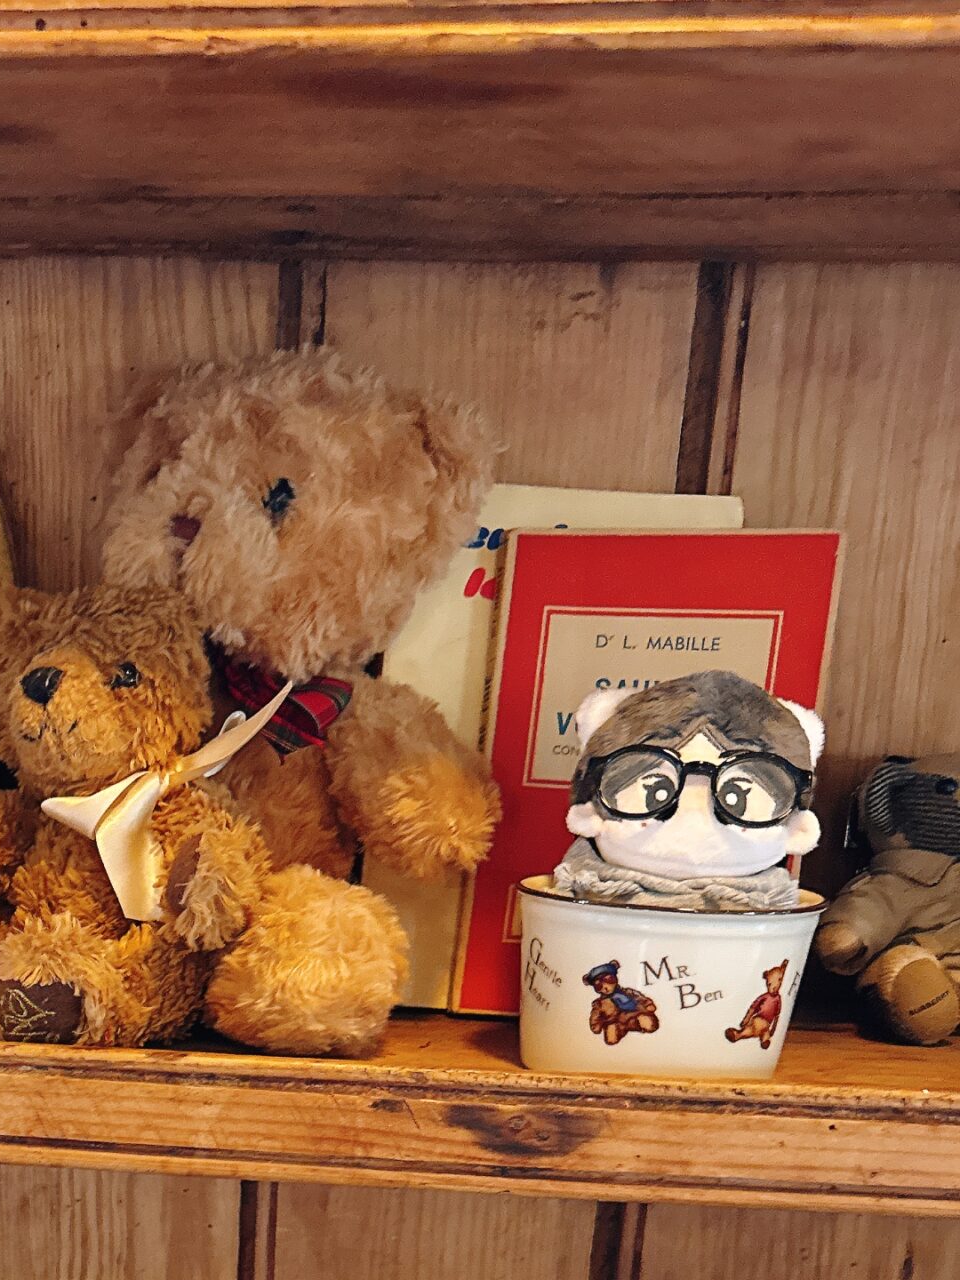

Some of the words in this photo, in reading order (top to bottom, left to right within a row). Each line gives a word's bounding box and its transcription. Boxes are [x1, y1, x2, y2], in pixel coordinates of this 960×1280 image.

[623, 638, 637, 650] L.
[646, 636, 722, 652] MABILLE
[674, 982, 725, 1010] Ben
